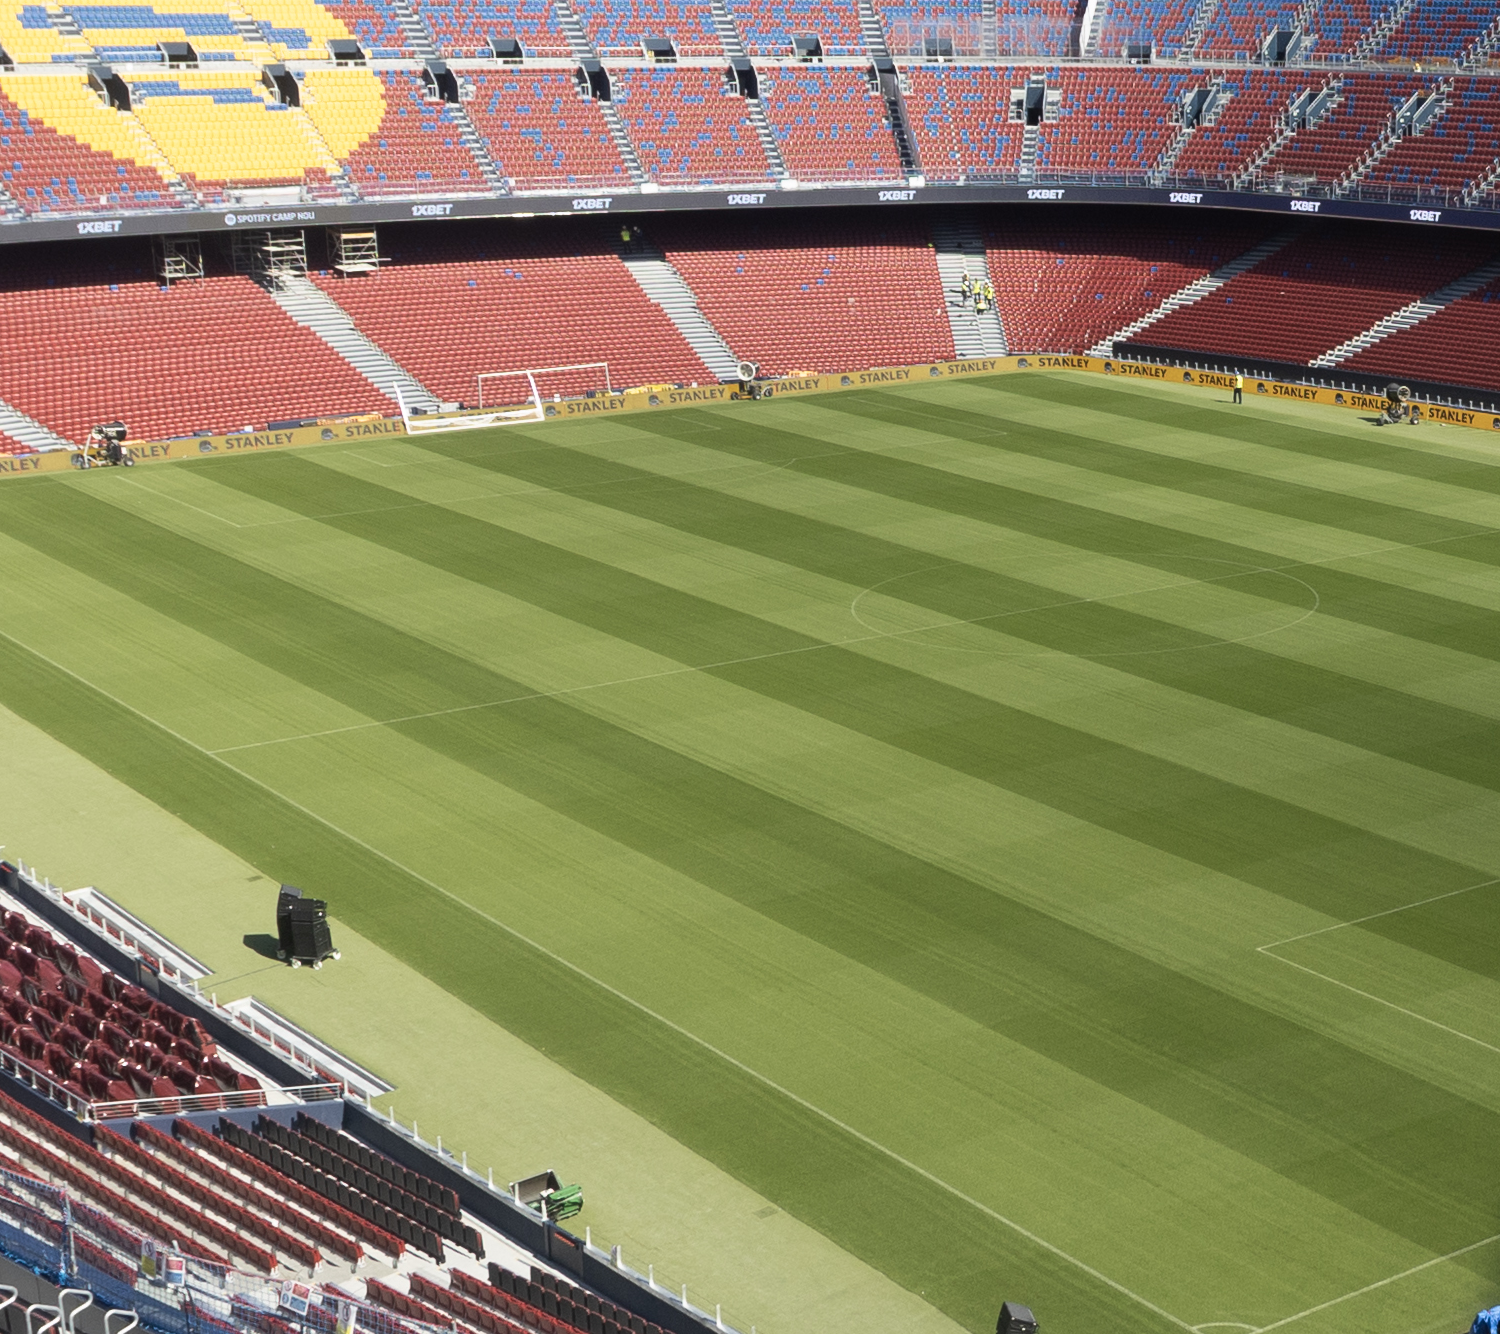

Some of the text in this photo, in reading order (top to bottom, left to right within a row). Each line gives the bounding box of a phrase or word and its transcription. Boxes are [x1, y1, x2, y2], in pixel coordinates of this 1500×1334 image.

[727, 193, 766, 205] 1XBET
[878, 190, 916, 201] 1XBET
[1027, 189, 1065, 200] 1XBET
[1169, 192, 1203, 203] 1XBET
[411, 203, 453, 216] 1XBET
[571, 197, 613, 210] 1XBET
[1290, 199, 1321, 212] 1XBET
[237, 211, 315, 224] SPOTIFY CAMP NOU
[1410, 208, 1441, 222] 1XBET
[77, 220, 122, 234] 1XBET
[948, 360, 997, 375] STANLEY
[1038, 357, 1089, 369] STANLEY
[859, 369, 911, 384] STANLEY
[1120, 363, 1167, 379] STANLEY
[771, 378, 821, 393] TANLEY
[1198, 373, 1236, 388] STANLE
[669, 387, 726, 403] STANLEY
[1272, 384, 1318, 401] STANLEY
[567, 398, 626, 414] STANLEY
[1428, 407, 1475, 425] STANLEY
[225, 432, 294, 450] STANLEY
